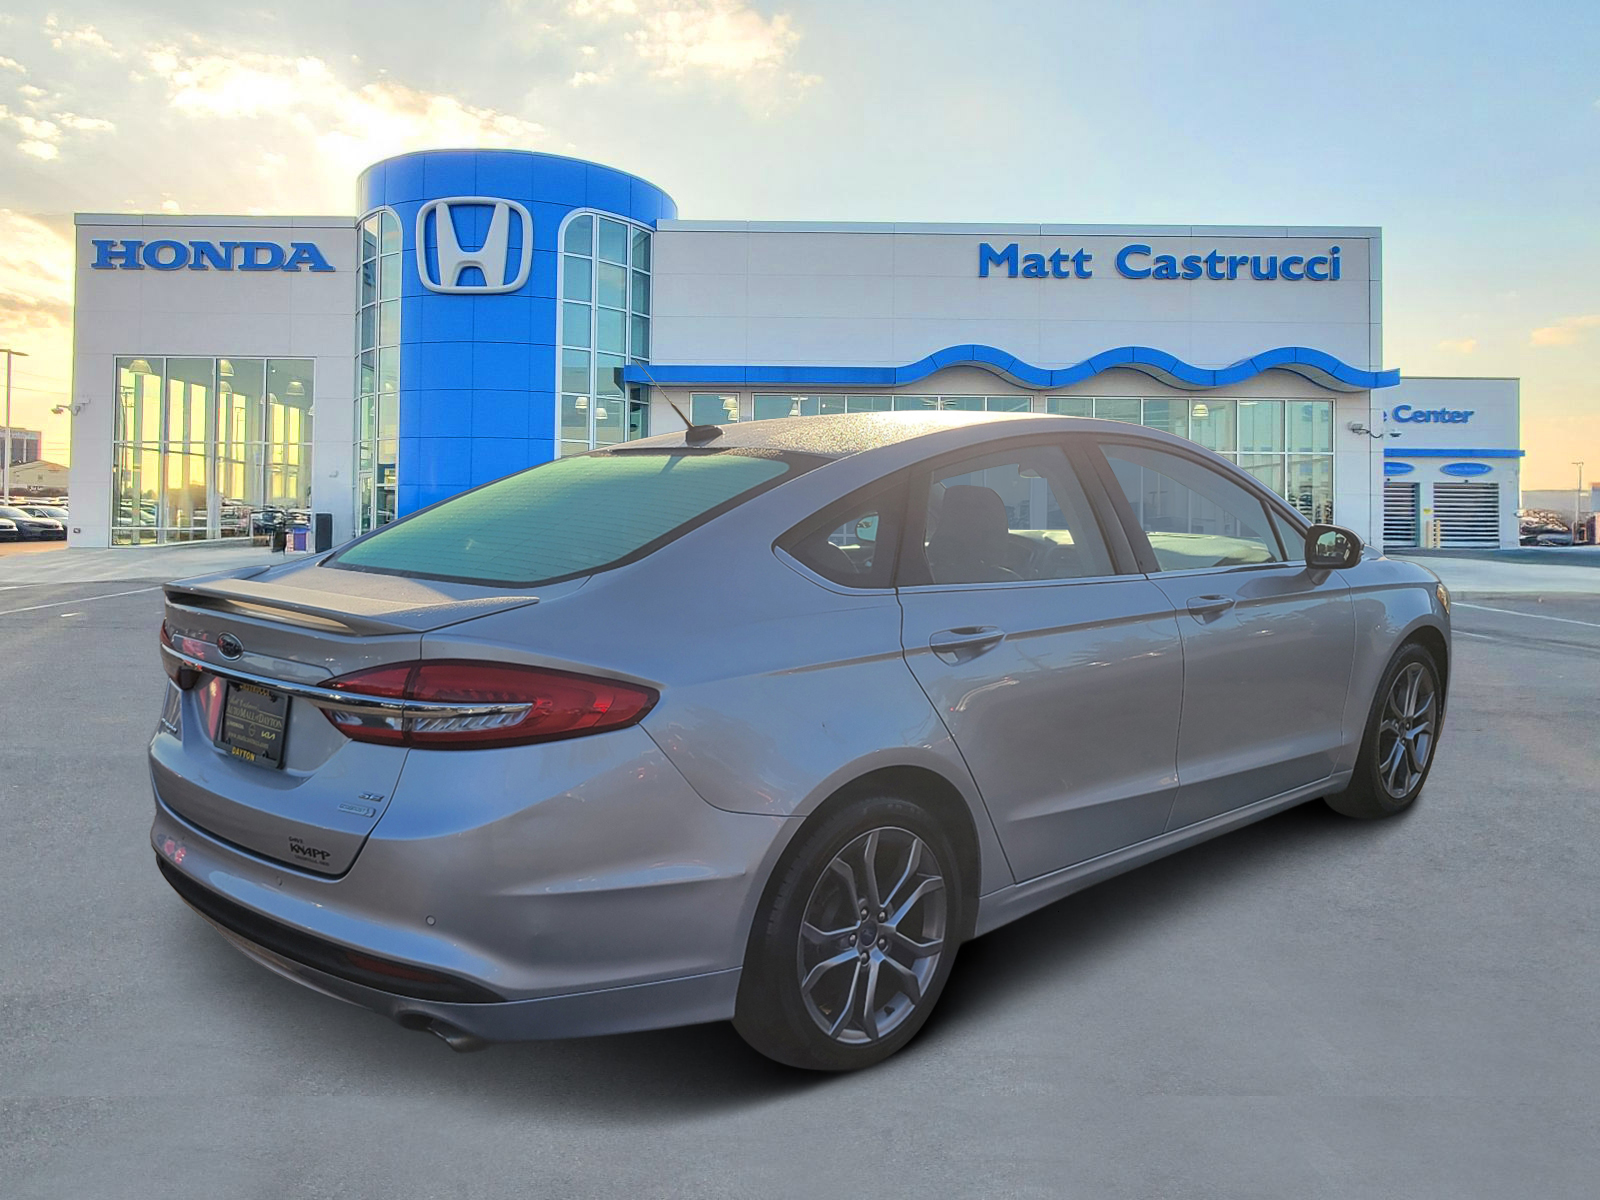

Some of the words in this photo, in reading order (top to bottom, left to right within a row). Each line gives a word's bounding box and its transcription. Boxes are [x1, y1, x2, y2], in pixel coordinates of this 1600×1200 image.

[91, 239, 336, 272] HONDA
[978, 242, 1093, 279] Matt
[1114, 244, 1342, 281] Castrucci
[1392, 404, 1475, 424] Center
[231, 746, 256, 761] DAYTON
[290, 843, 331, 861] KNAPP
